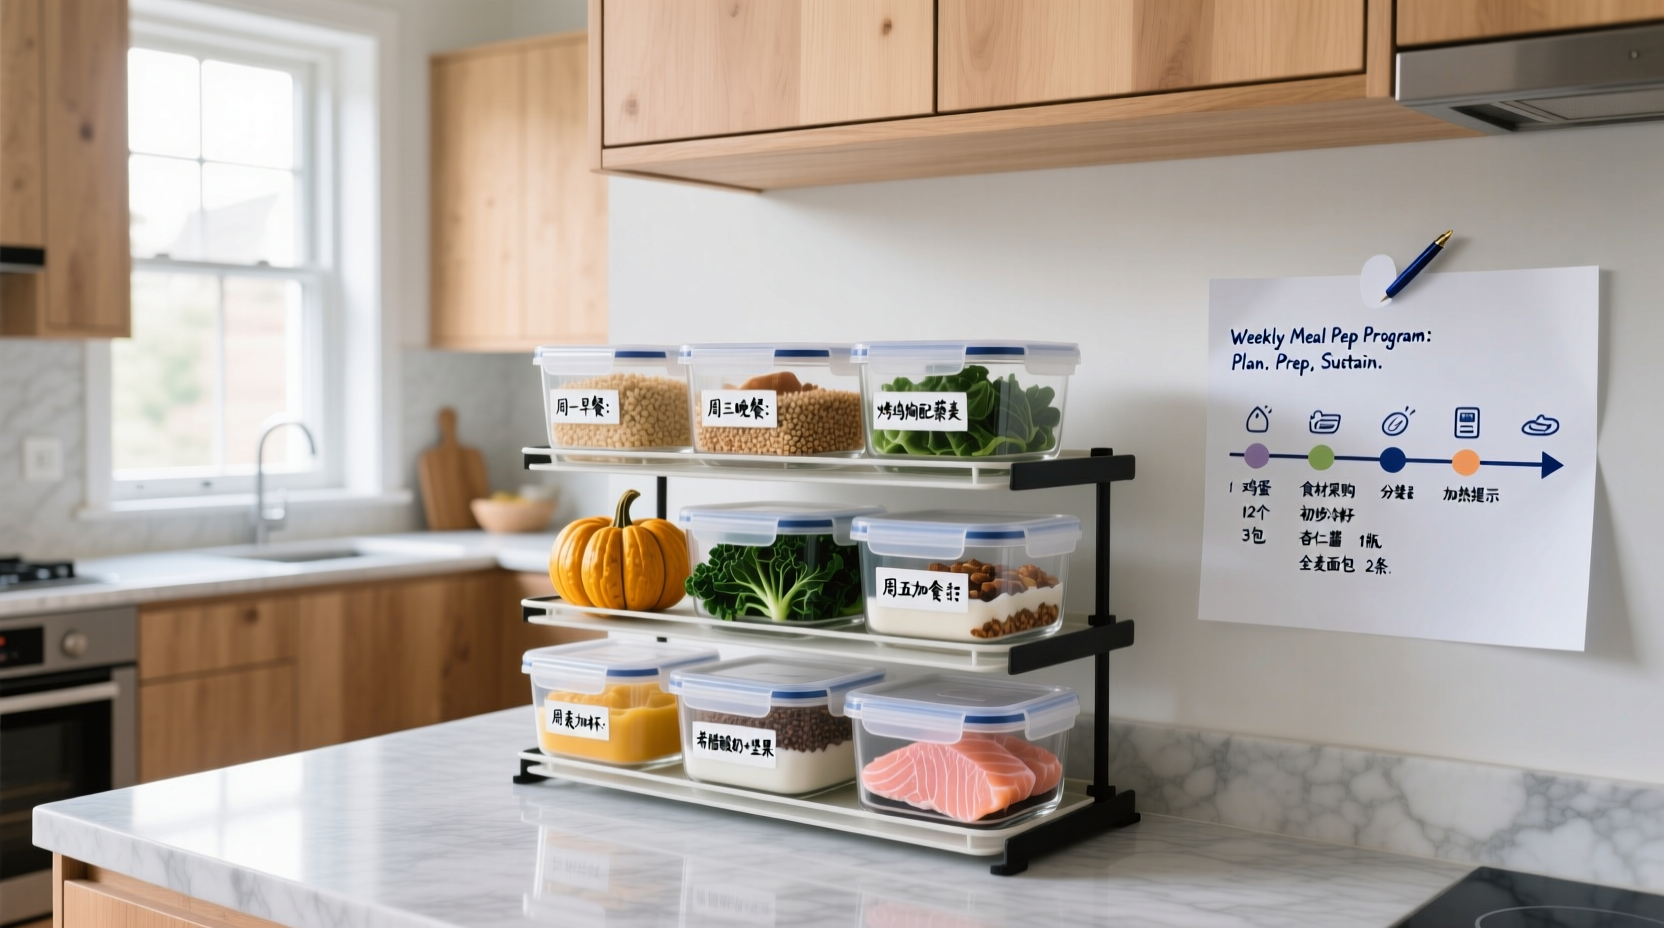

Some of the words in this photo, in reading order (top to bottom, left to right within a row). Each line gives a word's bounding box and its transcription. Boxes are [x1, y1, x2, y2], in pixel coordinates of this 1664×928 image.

[1230, 327, 1285, 350] Weekly
[1289, 326, 1327, 345] Meal
[1331, 326, 1359, 350] Pep
[1363, 325, 1433, 350] Program:
[1231, 353, 1270, 371] Plan.
[1275, 353, 1315, 377] Prep,
[1242, 504, 1271, 521] 12个
[1241, 526, 1267, 545] 3包
[1298, 553, 1357, 574] 全麦面包
